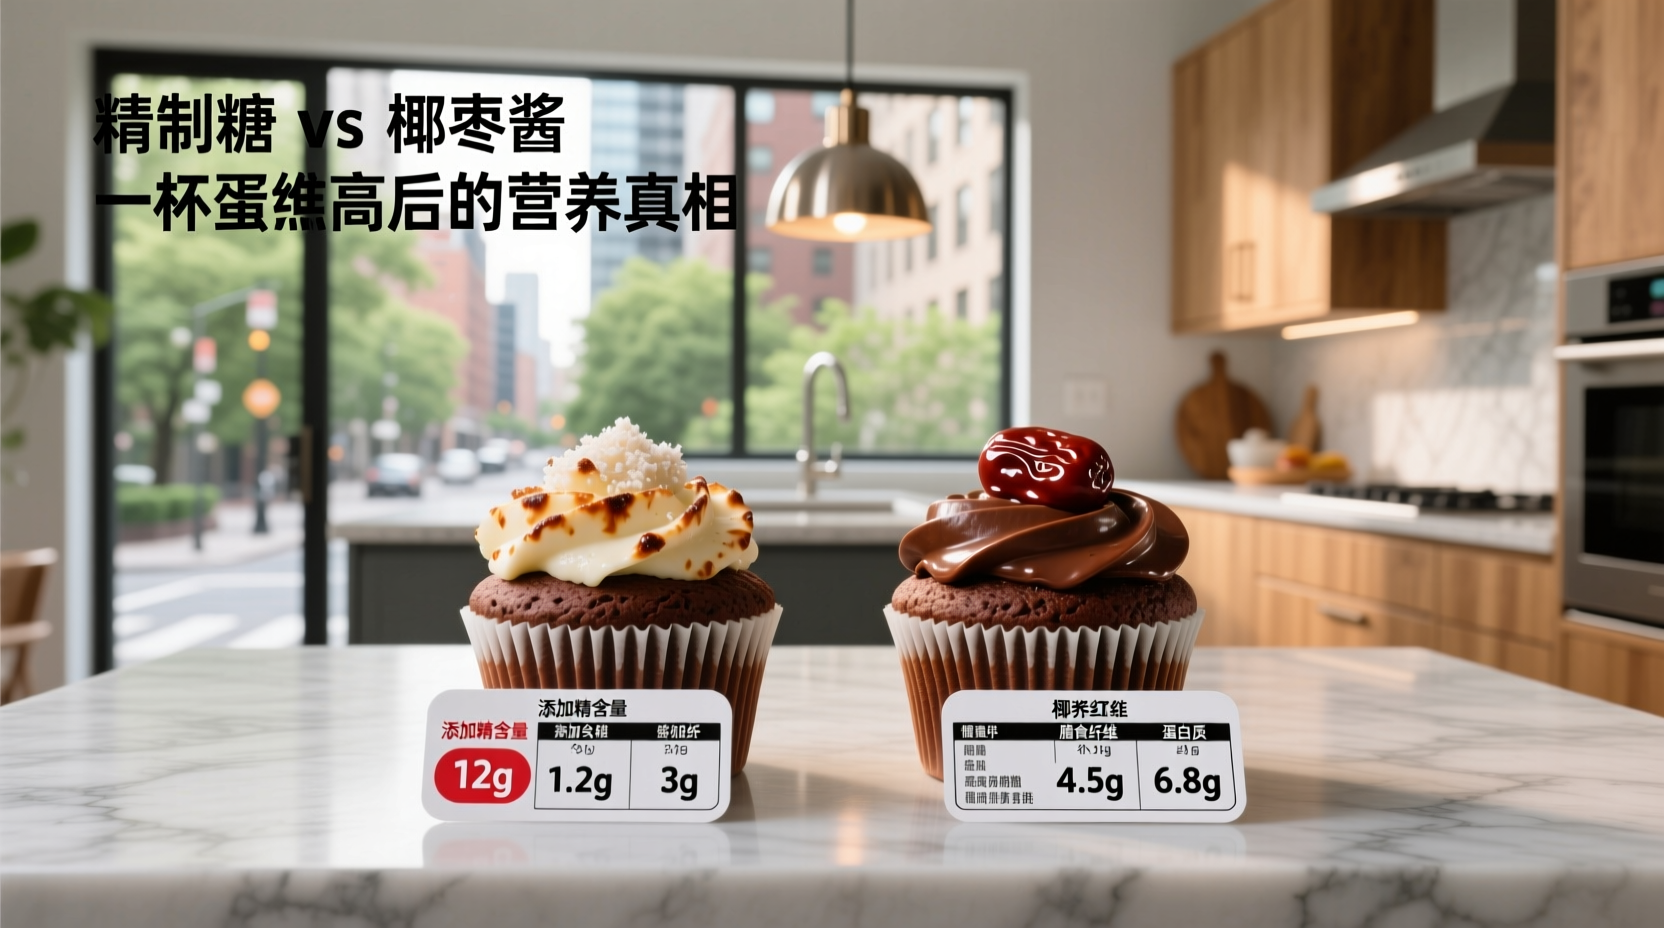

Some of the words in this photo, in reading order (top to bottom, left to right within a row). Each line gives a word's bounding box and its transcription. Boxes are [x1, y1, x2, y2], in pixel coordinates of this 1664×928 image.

[454, 759, 513, 798] 12g
[549, 766, 612, 801] 1.2g
[660, 766, 698, 801] 3g
[1056, 766, 1123, 801] 4.5g
[1154, 766, 1221, 801] 6.8g
